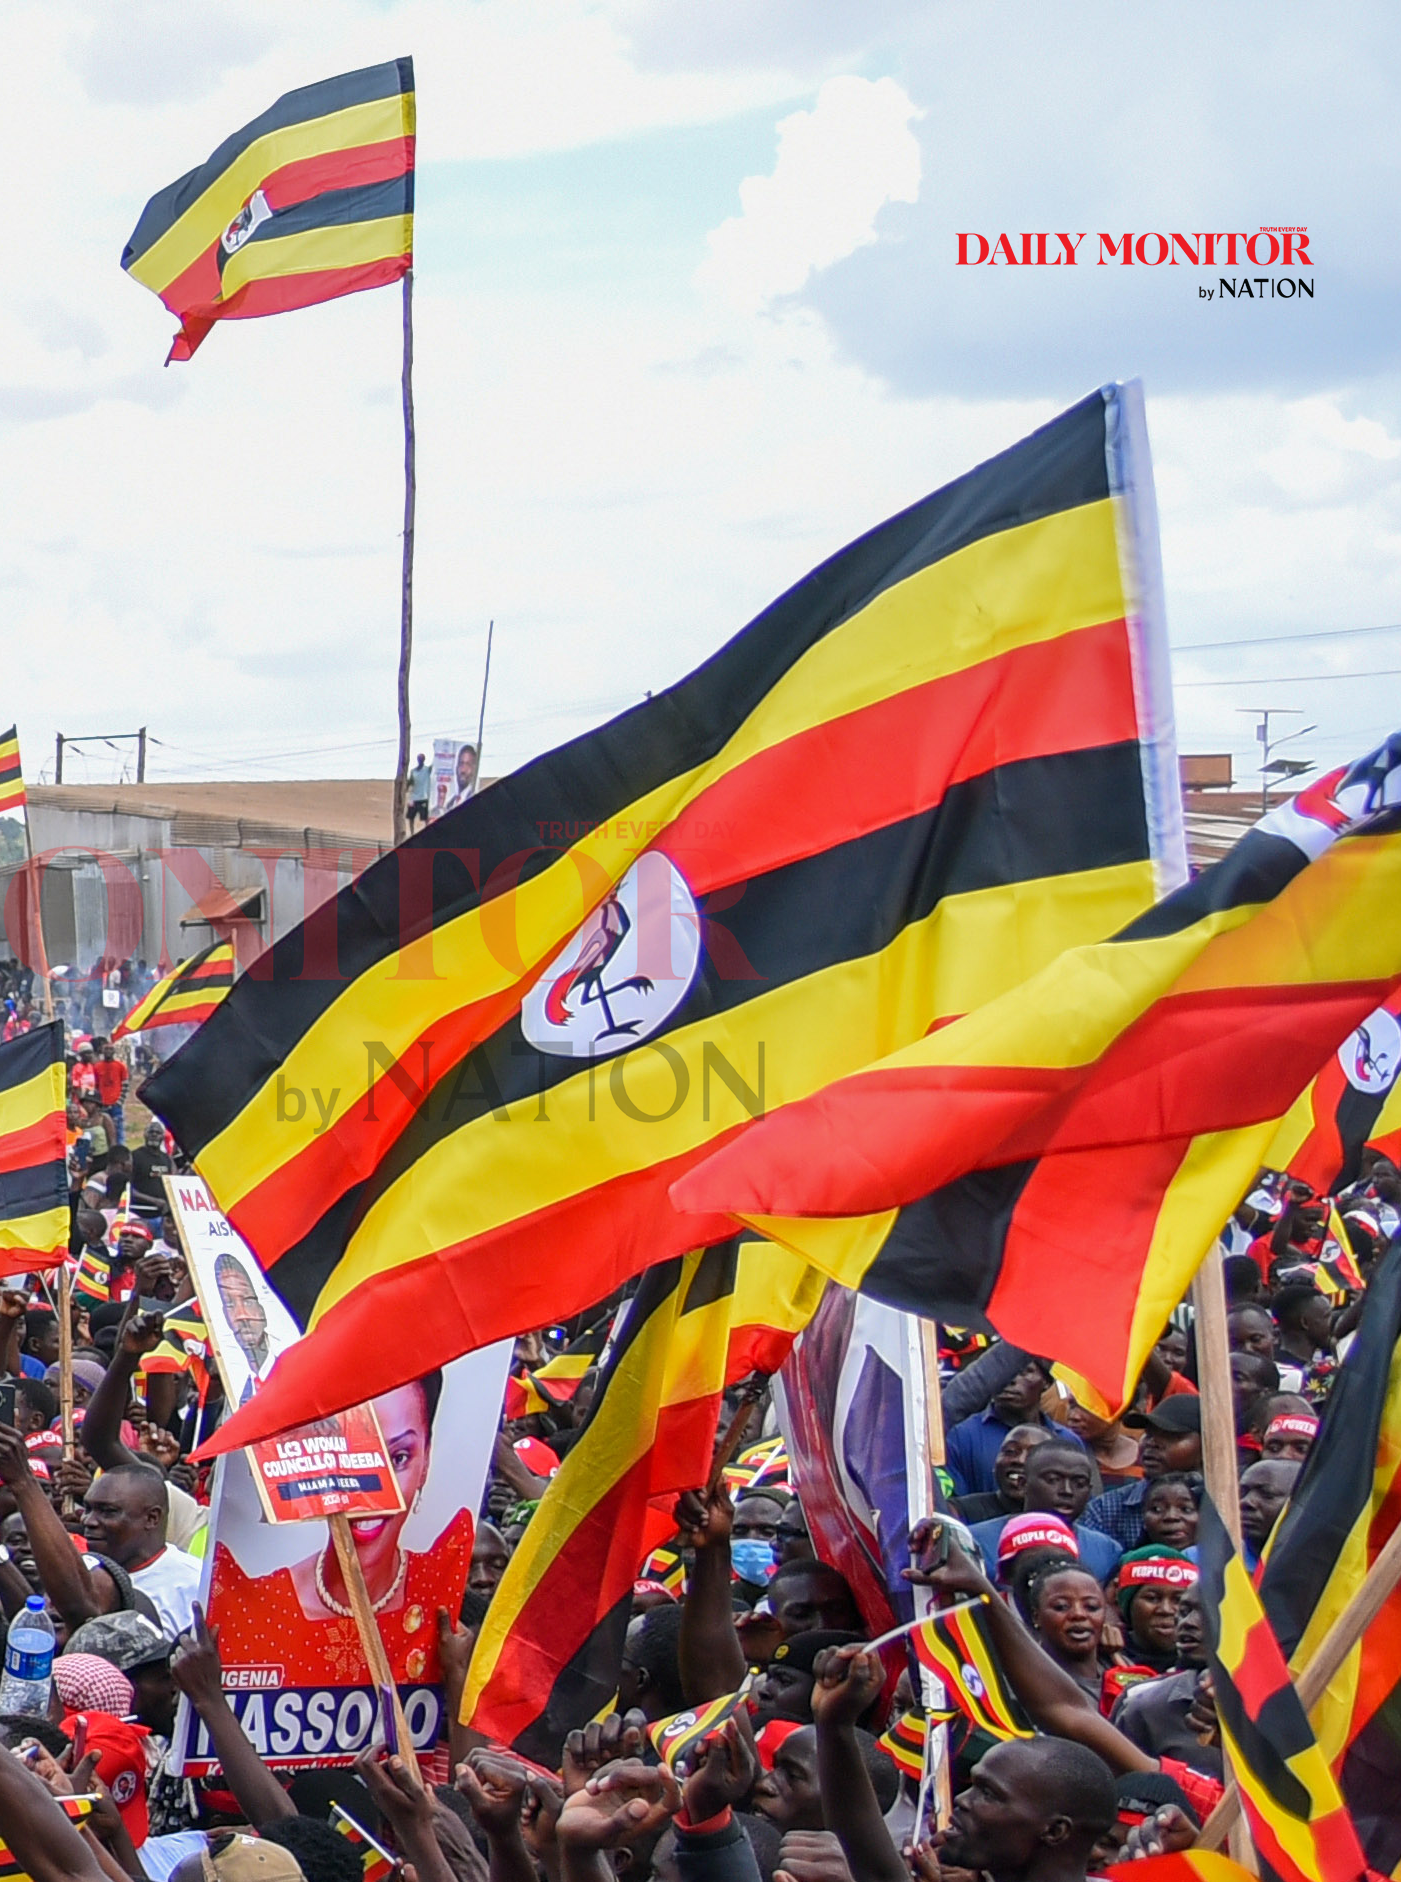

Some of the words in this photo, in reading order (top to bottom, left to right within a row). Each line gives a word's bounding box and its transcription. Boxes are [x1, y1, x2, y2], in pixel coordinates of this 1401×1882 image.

[276, 1440, 303, 1459] LC3
[302, 1436, 348, 1454] WOMAN
[1012, 1530, 1046, 1548] PEOPLE
[1131, 1565, 1165, 1579] PEOPLE
